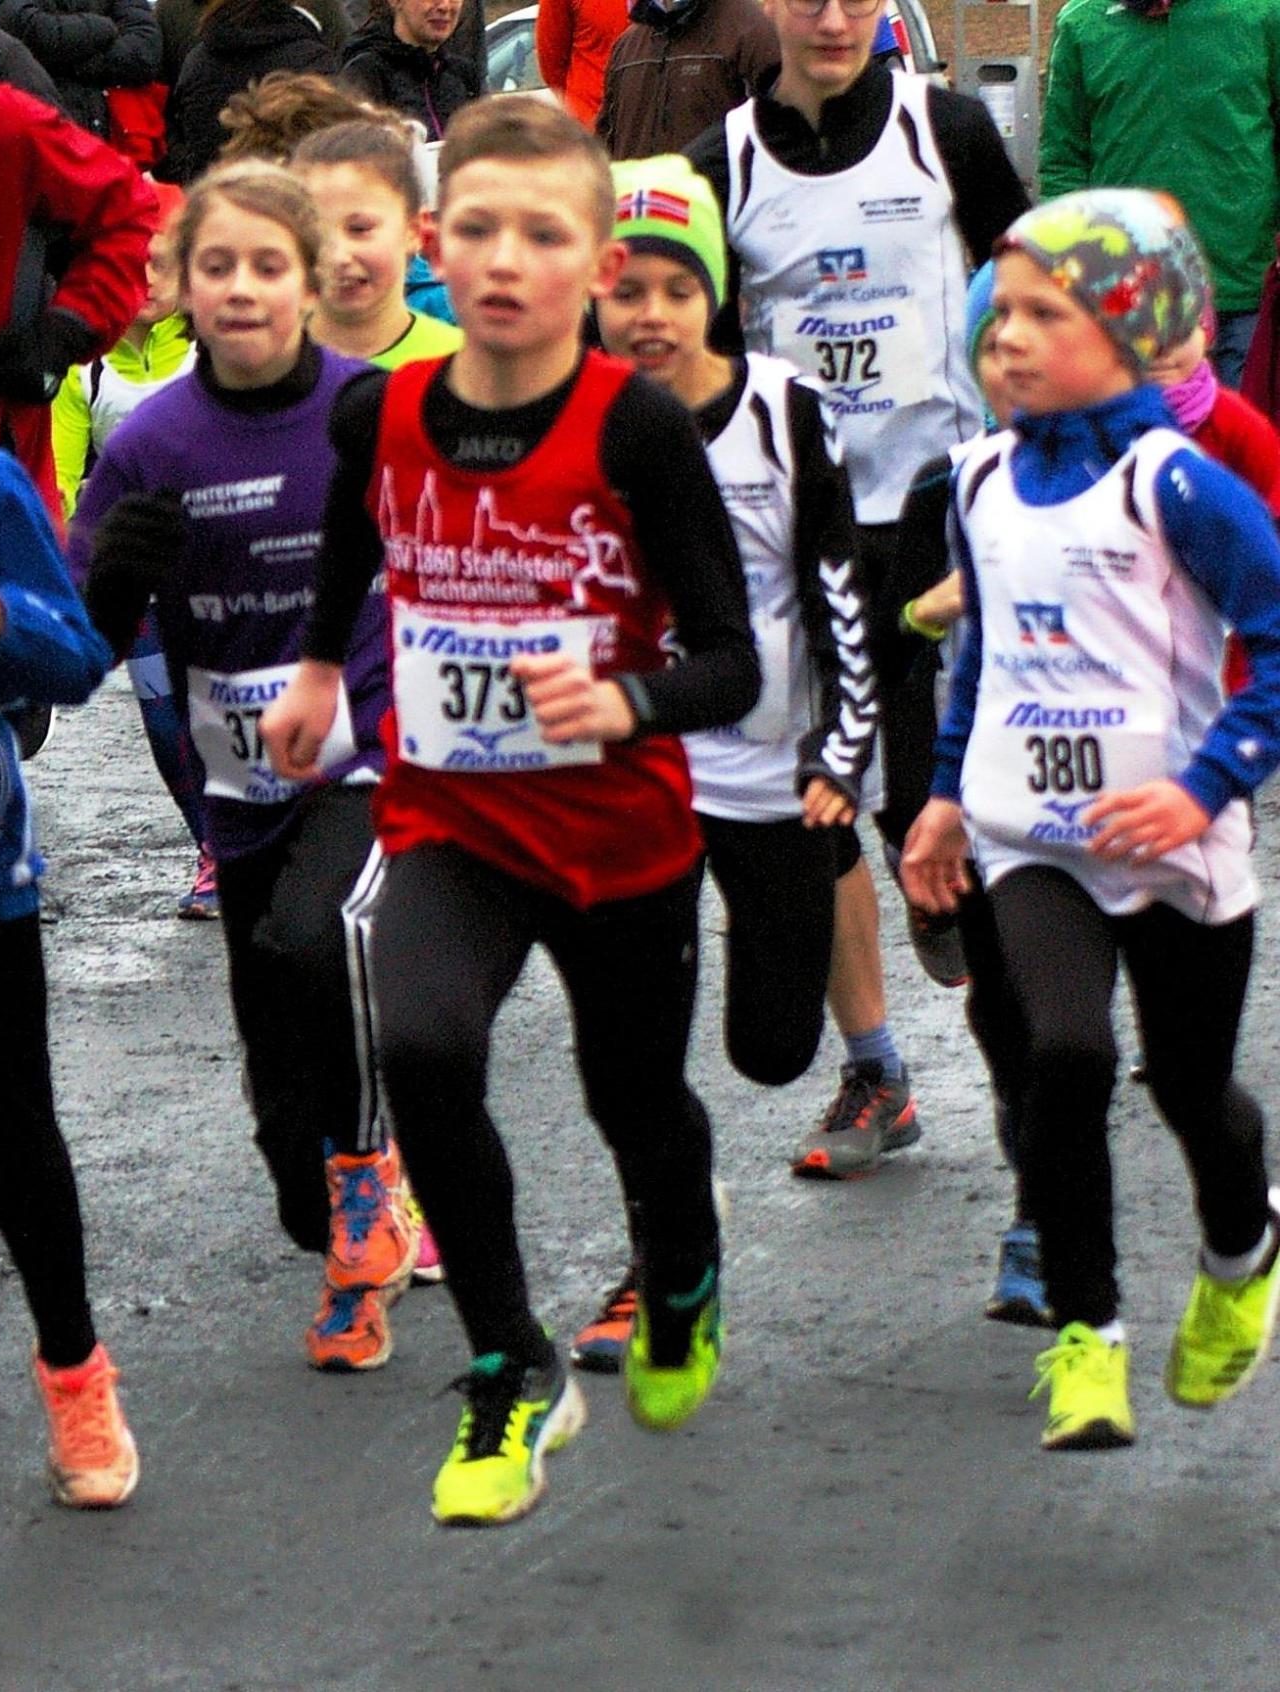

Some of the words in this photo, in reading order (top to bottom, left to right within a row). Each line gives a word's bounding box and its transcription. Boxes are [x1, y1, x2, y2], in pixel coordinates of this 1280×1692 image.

[815, 339, 881, 383] 372
[461, 547, 574, 582] Staffelstein
[440, 661, 526, 723] 373
[1026, 734, 1103, 794] 380
